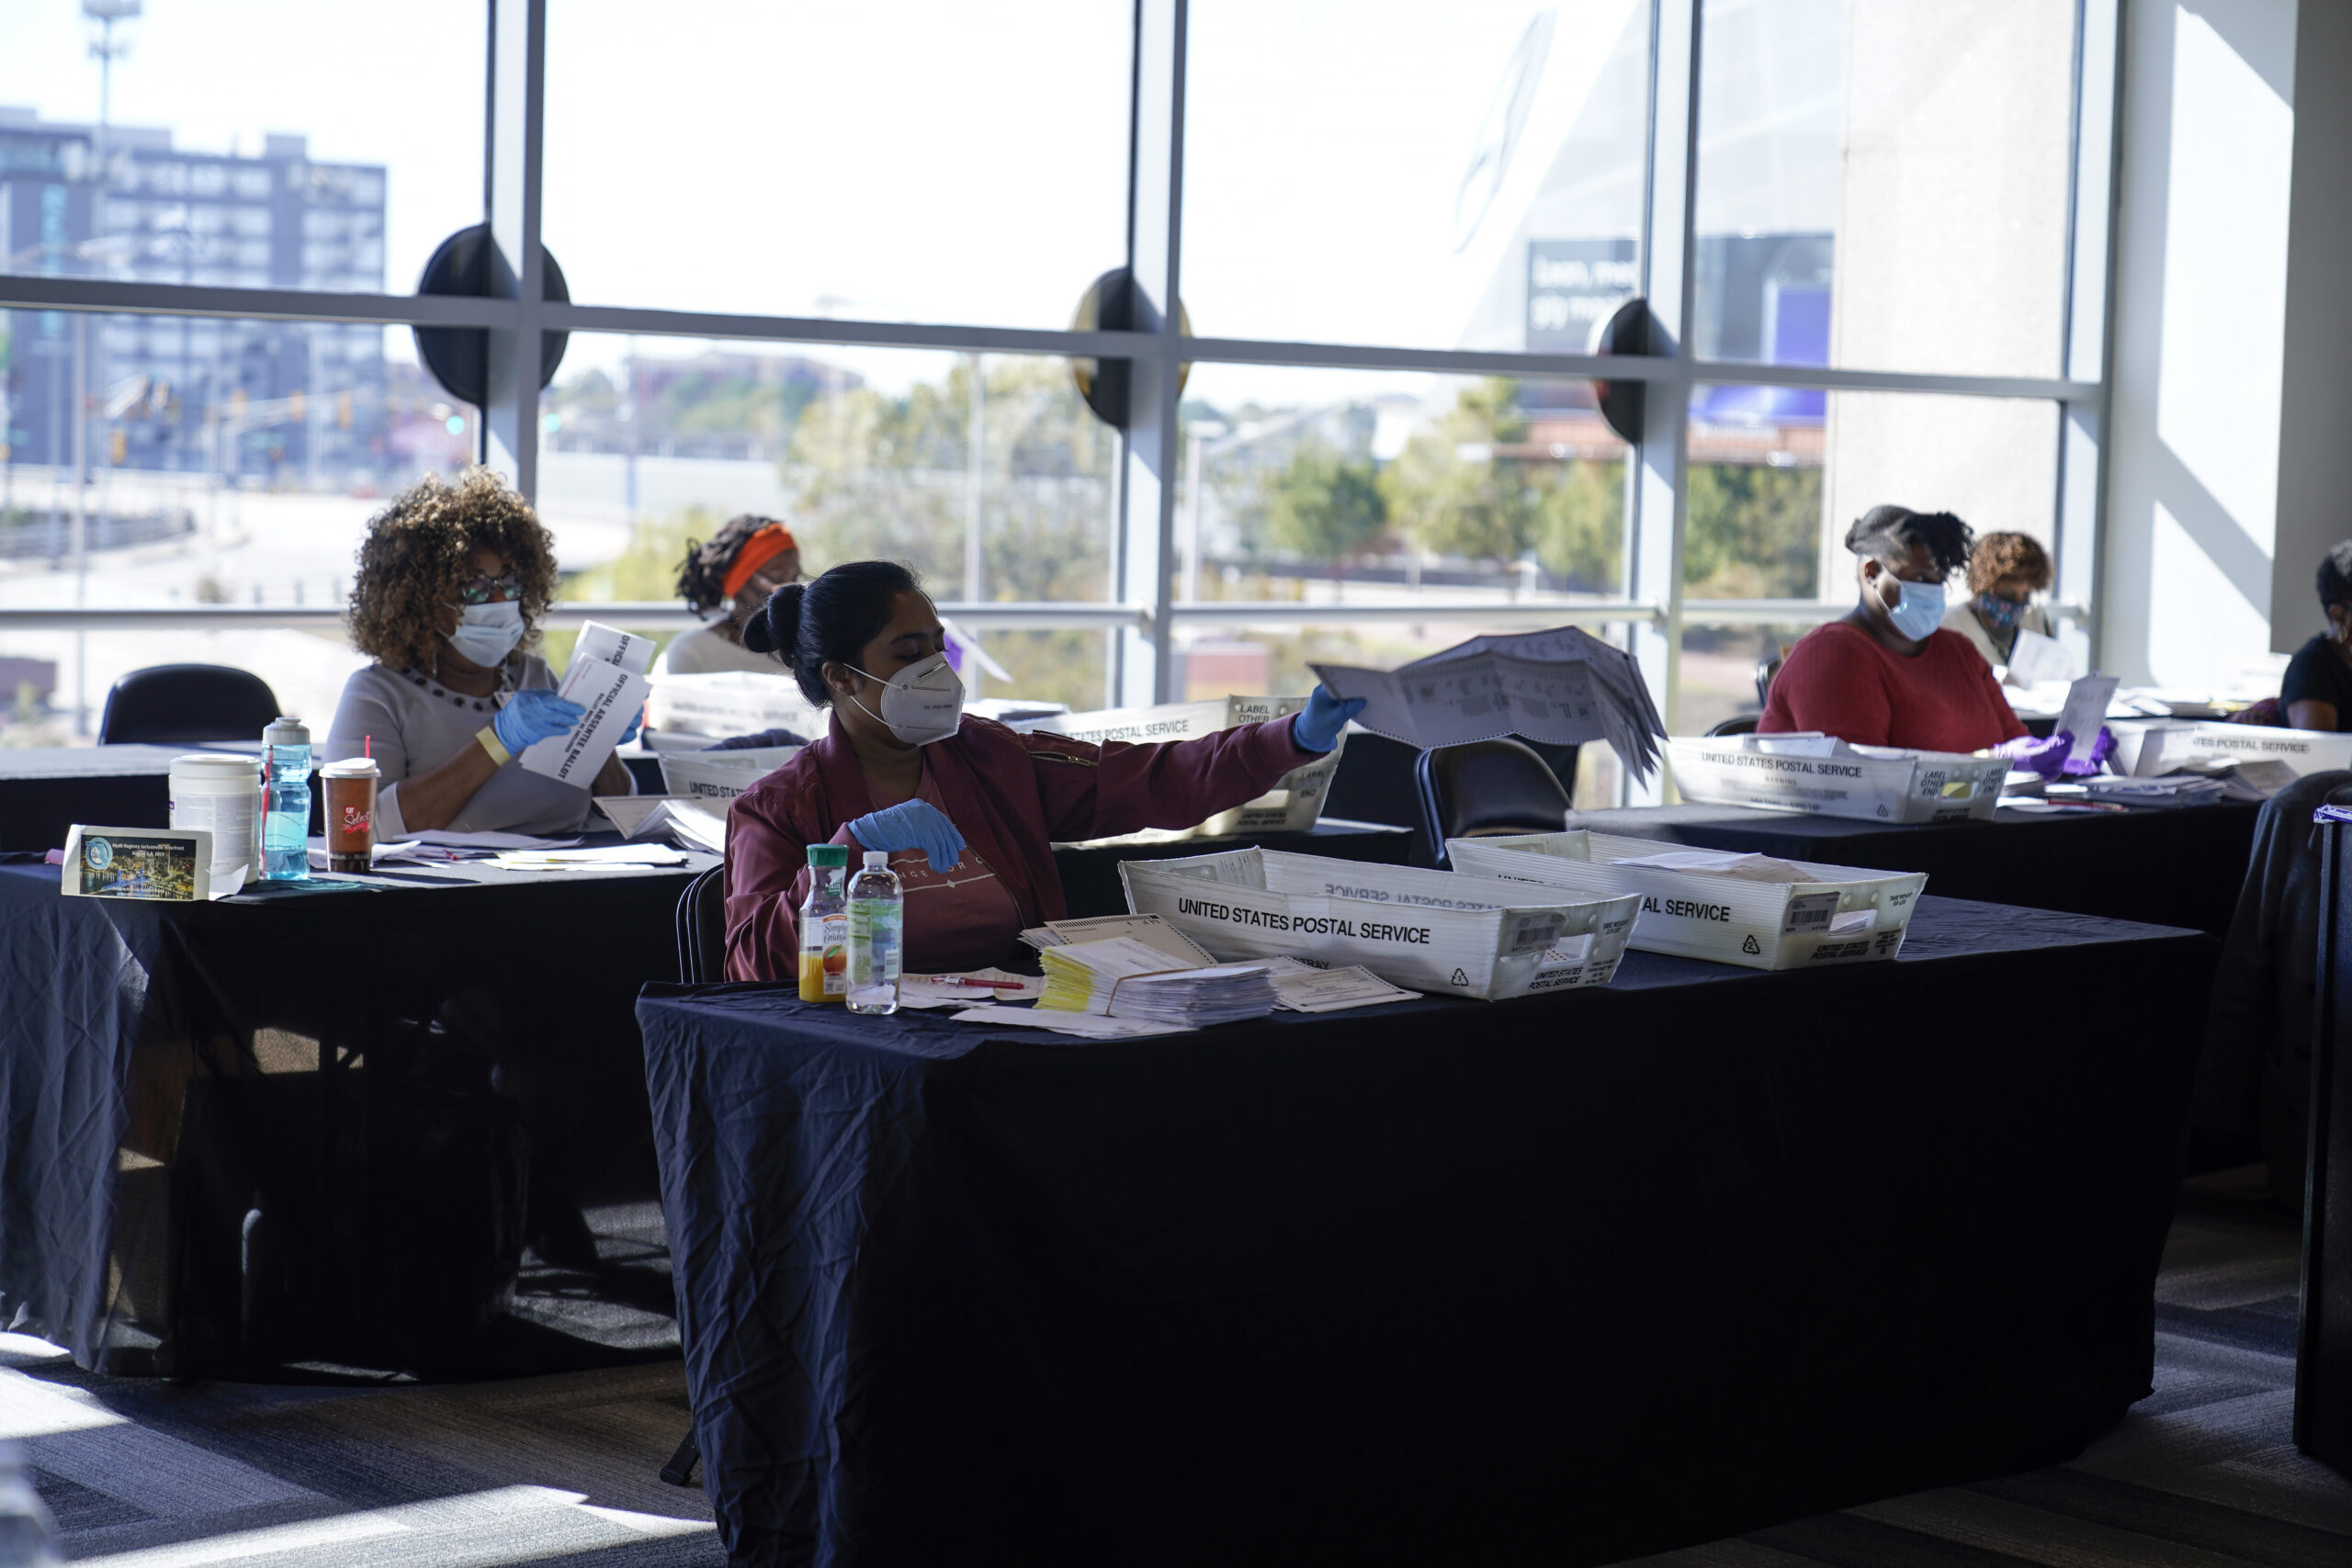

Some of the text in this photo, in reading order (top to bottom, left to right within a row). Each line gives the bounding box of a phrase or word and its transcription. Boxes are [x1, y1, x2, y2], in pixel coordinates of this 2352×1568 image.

[611, 635, 631, 667] OFFICI
[1240, 705, 1270, 714] LABEL
[558, 672, 628, 779] OFFICIAL ABSENTEE BALLOT
[1238, 715, 1270, 723] OTHER
[1104, 727, 1142, 740] POSTAL
[1146, 720, 1189, 736] SERVICE
[2216, 739, 2257, 750] POSTAL
[2261, 741, 2310, 754] SERVICE
[1702, 751, 1862, 779] UNITED STATES POSTAL SERVICE
[689, 781, 744, 798] UNITED STAT
[1920, 779, 1945, 787] OTHER
[1300, 790, 1317, 798] END
[1922, 788, 1939, 796] END
[899, 870, 929, 880] NGE
[1666, 899, 1731, 921] SERVICE
[824, 922, 847, 934] Simply
[1179, 897, 1430, 945] UNITED STATES POSTAL SERVICE
[1534, 967, 1583, 980] UNITED STATES
[1528, 976, 1581, 990] POSTAL SERVICE
